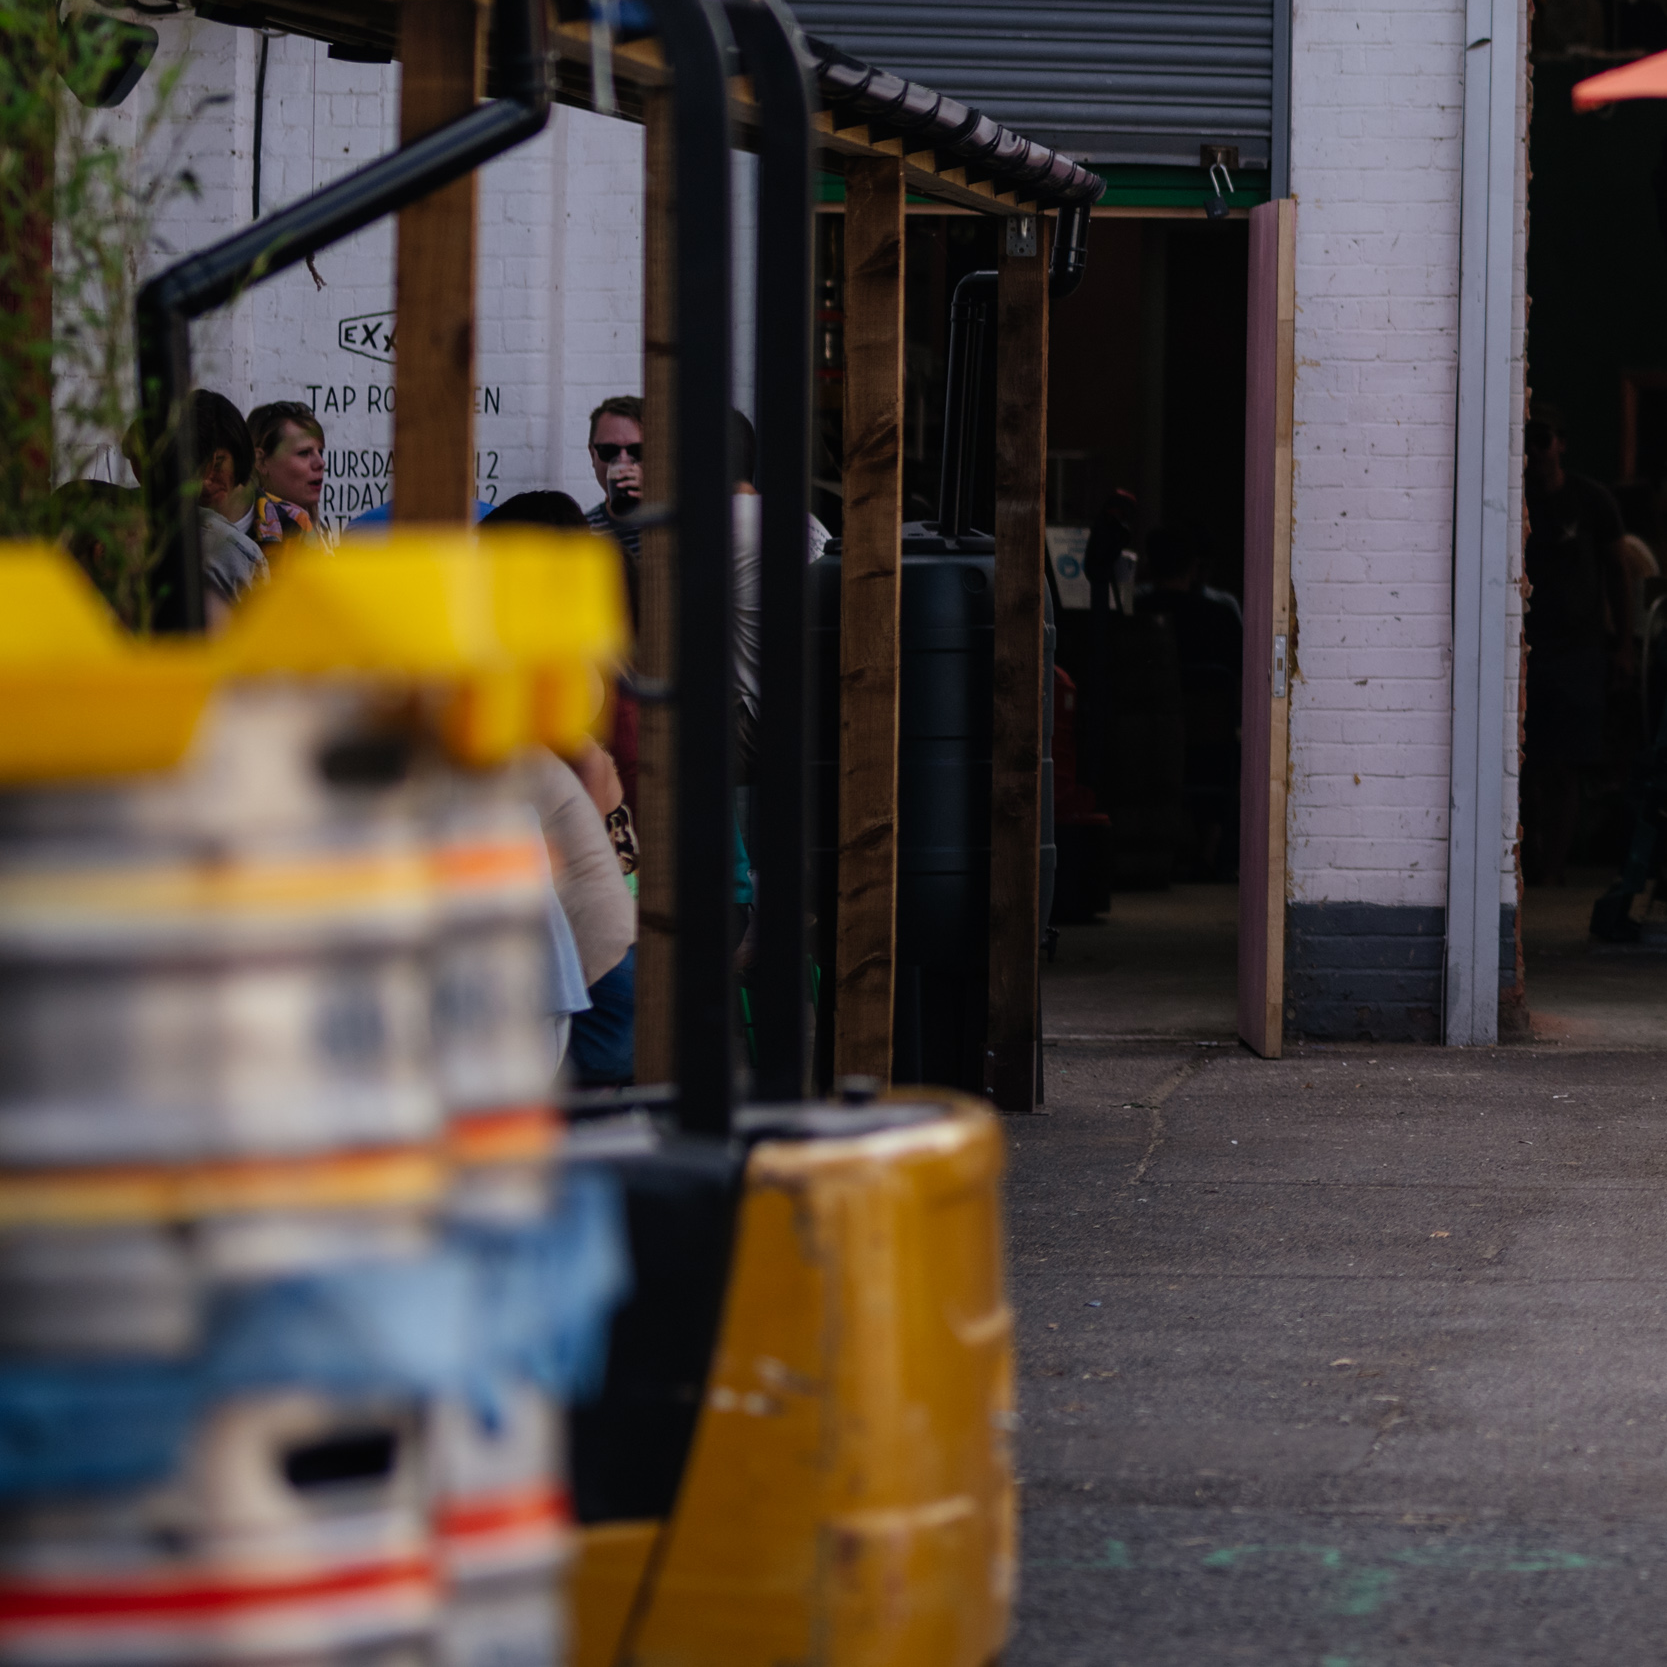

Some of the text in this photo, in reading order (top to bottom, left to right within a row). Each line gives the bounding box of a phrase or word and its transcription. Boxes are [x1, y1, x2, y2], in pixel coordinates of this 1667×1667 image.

[306, 385, 357, 414] TAP
[368, 385, 397, 413] RO
[323, 449, 396, 479] HURSDA
[323, 483, 389, 513] RIDAY
